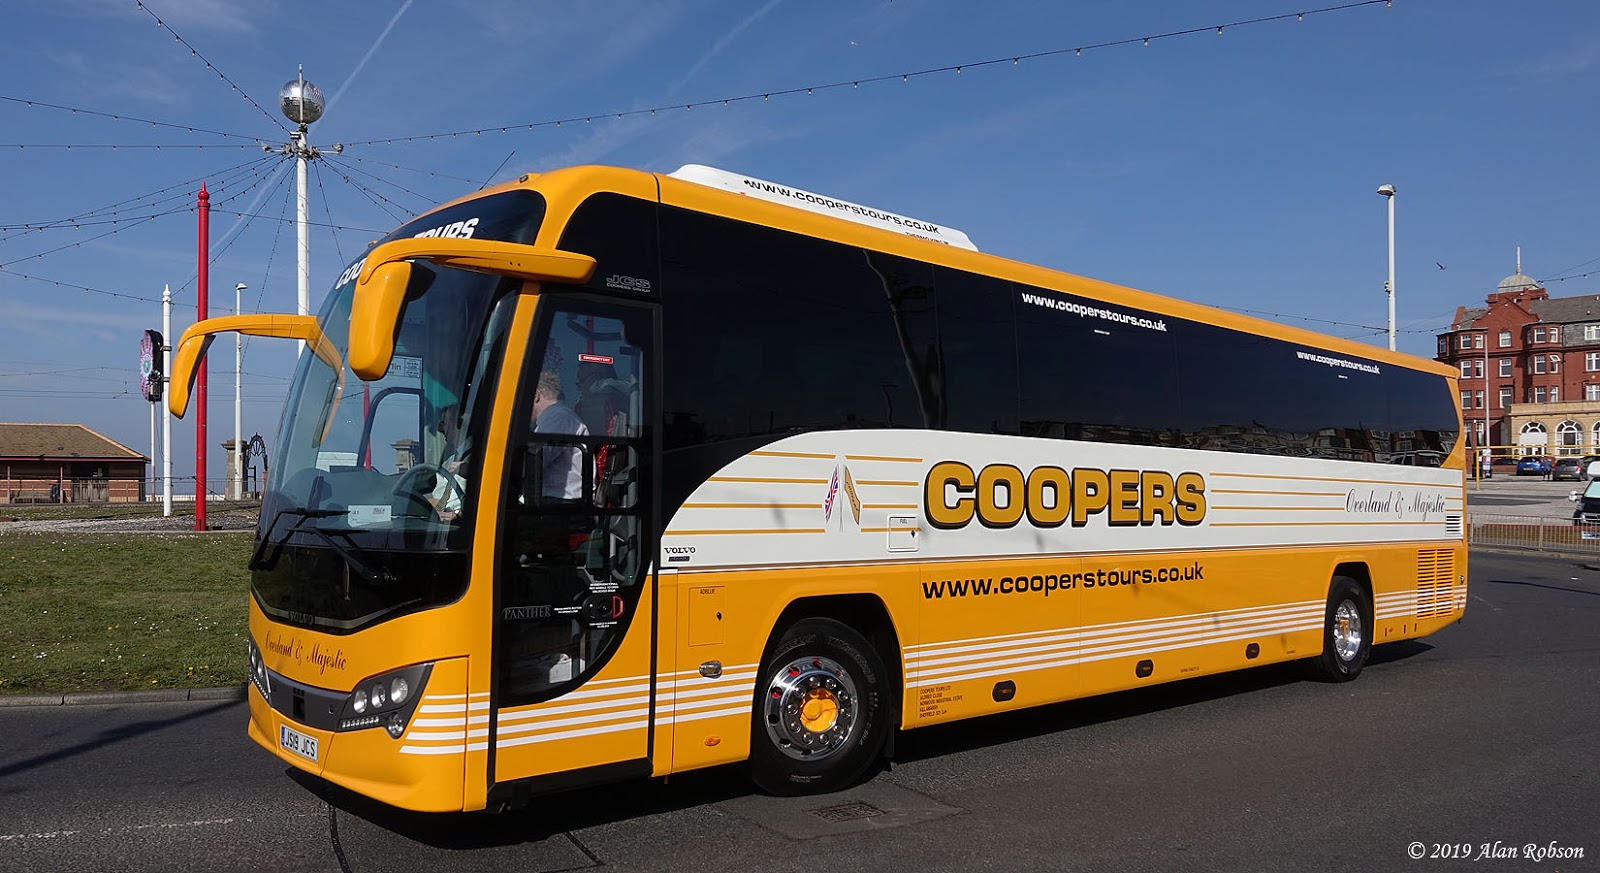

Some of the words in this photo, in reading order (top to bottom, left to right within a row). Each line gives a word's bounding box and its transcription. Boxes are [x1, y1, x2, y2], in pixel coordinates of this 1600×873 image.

[745, 180, 940, 234] www.cooperstours.co.uk
[414, 217, 480, 239] URS
[606, 274, 650, 289] JCS
[1021, 292, 1168, 333] www.cooperstours.co.uk
[1296, 350, 1381, 375] www.cooperstours.co.uk
[923, 460, 1207, 529] COOPERS
[1346, 488, 1392, 513] Overland
[1408, 491, 1445, 522] Majestic
[664, 546, 696, 554] VOLVO
[922, 562, 1205, 599] www.cooperstours.co.uk
[503, 606, 552, 620] PANTHER
[265, 630, 293, 658] Overland
[306, 643, 347, 675] Majestic
[301, 738, 315, 757] JCS
